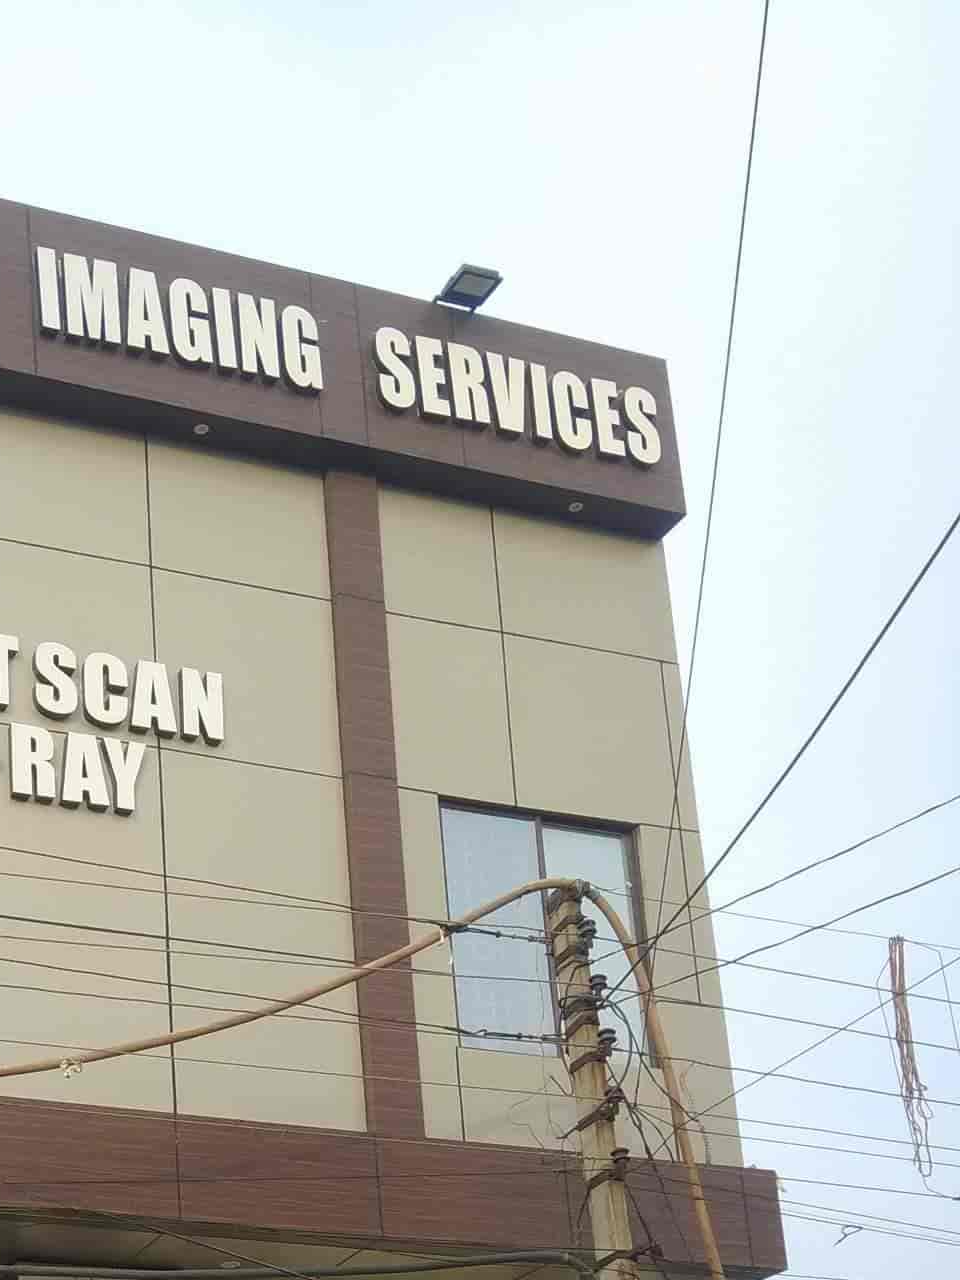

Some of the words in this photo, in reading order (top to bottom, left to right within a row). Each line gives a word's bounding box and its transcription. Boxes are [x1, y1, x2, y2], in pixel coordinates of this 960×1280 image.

[36, 246, 325, 392] IMAGING
[374, 326, 663, 467] SERVICES
[32, 641, 225, 745] SCAN
